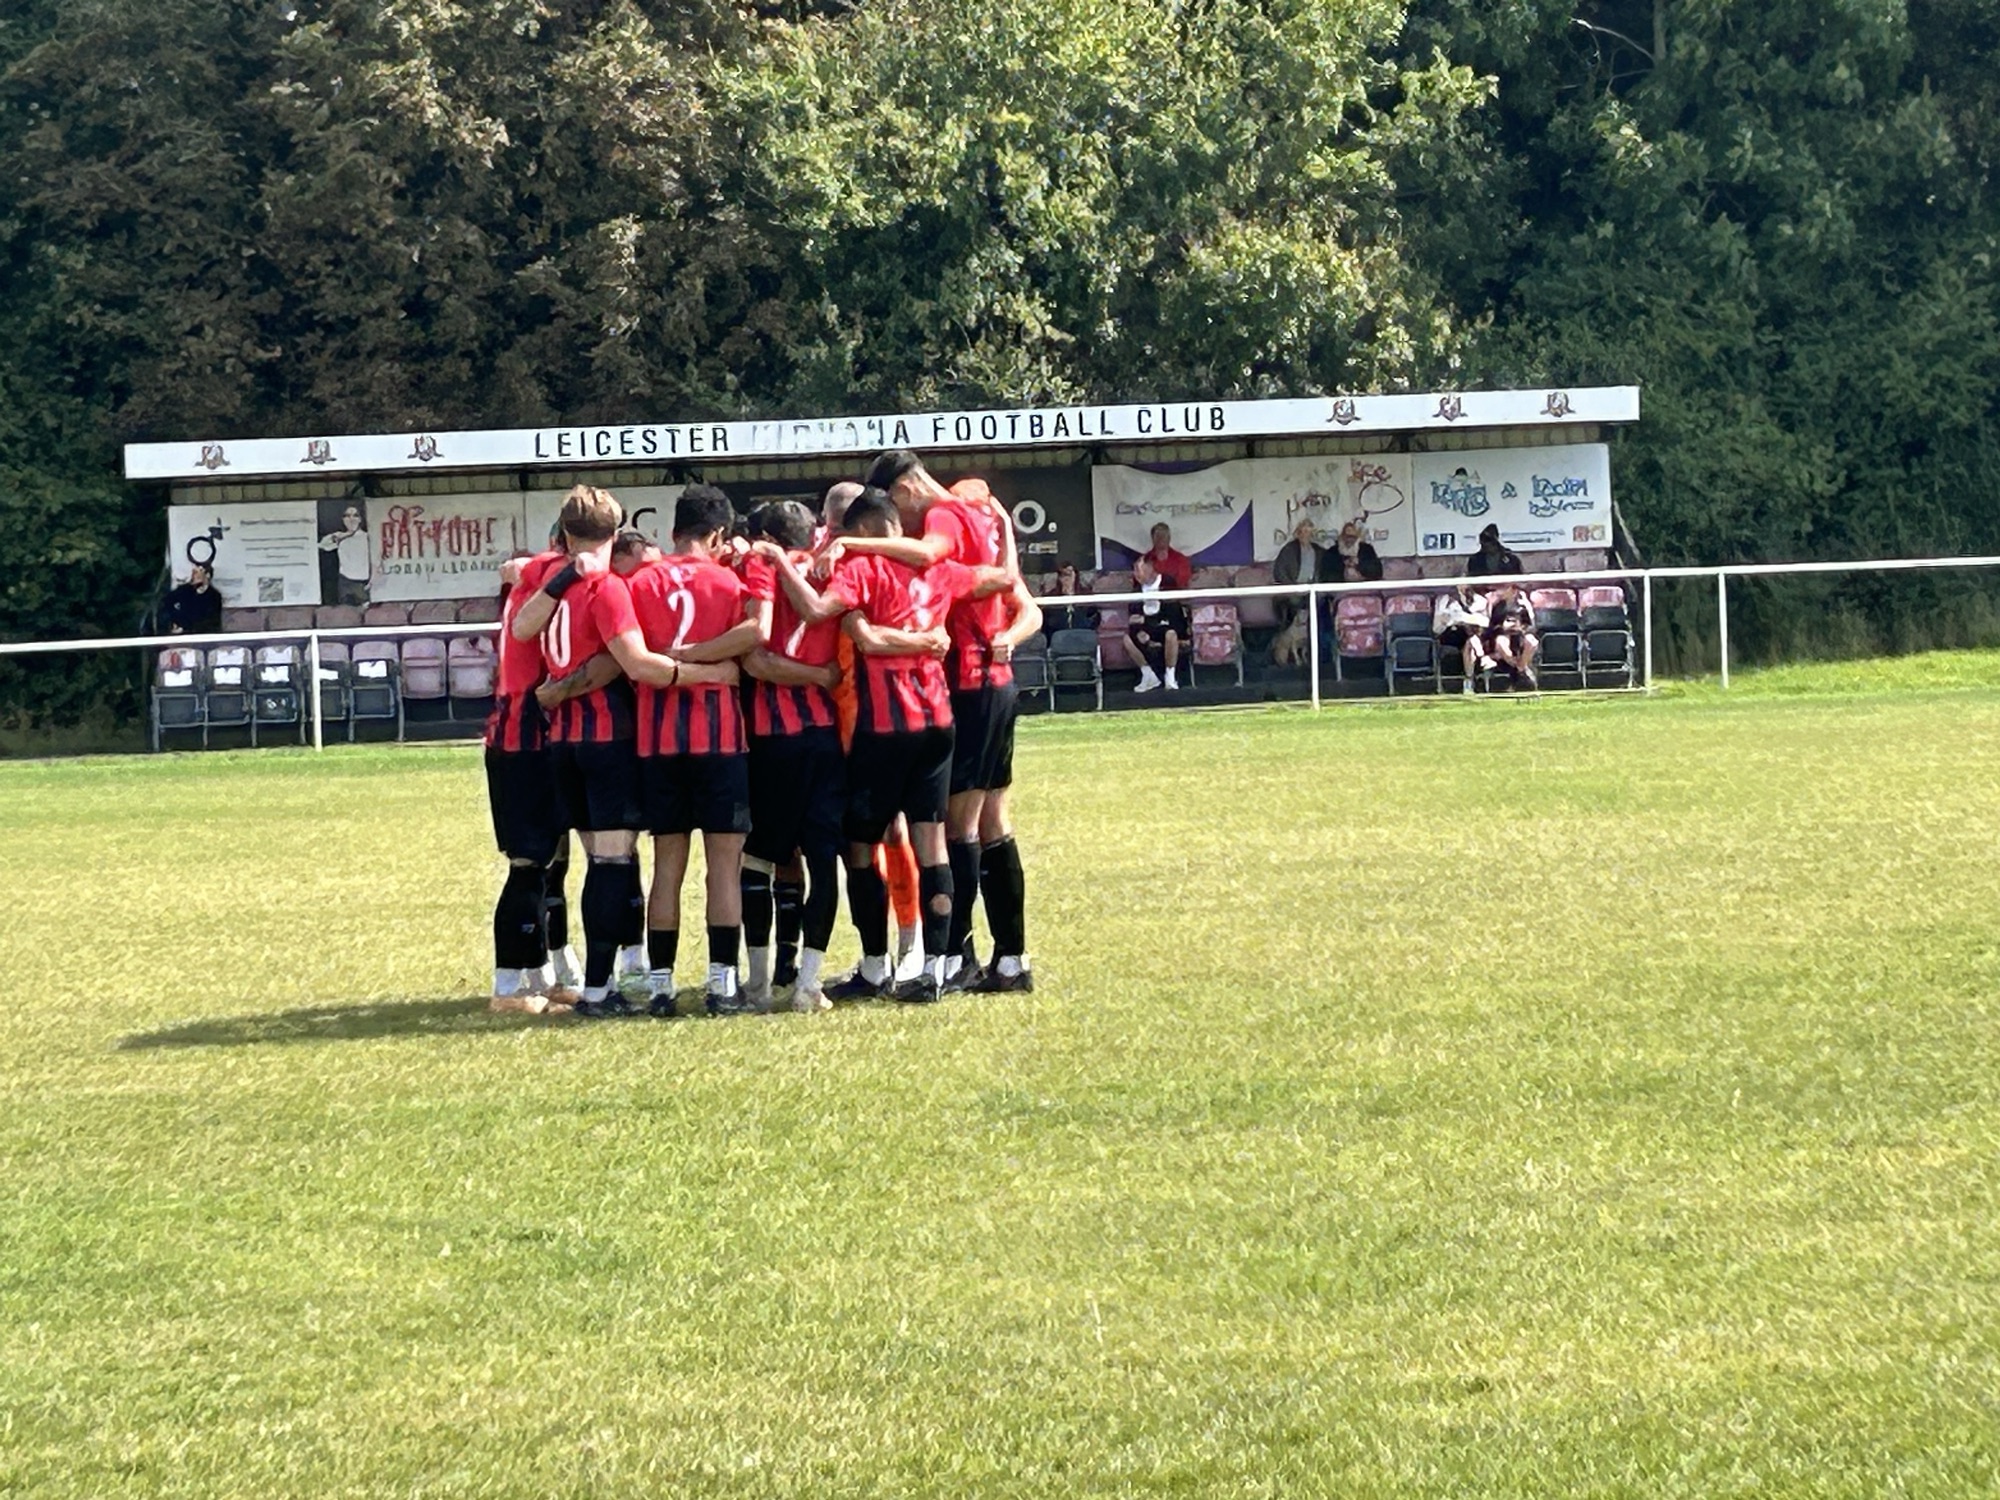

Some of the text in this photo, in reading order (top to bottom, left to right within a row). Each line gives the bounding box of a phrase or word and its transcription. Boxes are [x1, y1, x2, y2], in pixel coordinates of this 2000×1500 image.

[534, 427, 729, 458] LEICESTER
[932, 409, 1115, 444] FOOTBALL
[1138, 405, 1226, 434] CLUB
